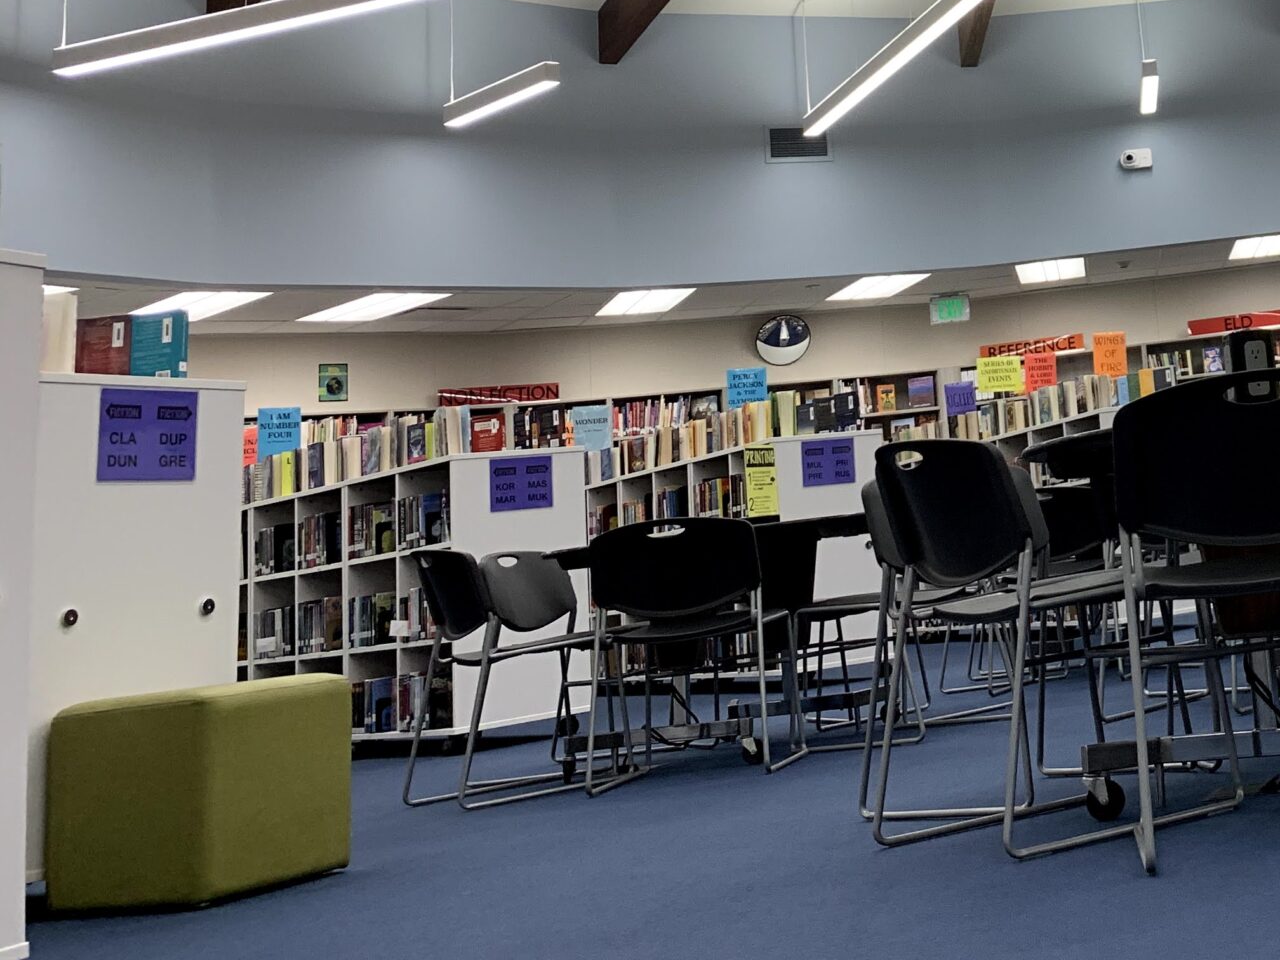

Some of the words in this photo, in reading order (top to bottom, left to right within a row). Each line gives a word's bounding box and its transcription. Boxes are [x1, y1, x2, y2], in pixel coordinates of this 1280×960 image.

[1224, 315, 1253, 331] ELD
[988, 337, 1077, 357] REFERENCE
[1105, 349, 1117, 358] OF
[575, 417, 608, 425] WONDER
[109, 431, 137, 445] CLA
[160, 433, 187, 445] DUP
[267, 431, 292, 439] FOUR
[107, 455, 137, 467] DUN
[159, 455, 187, 467] GRE
[528, 480, 548, 488] MAS
[495, 496, 516, 504] MAR
